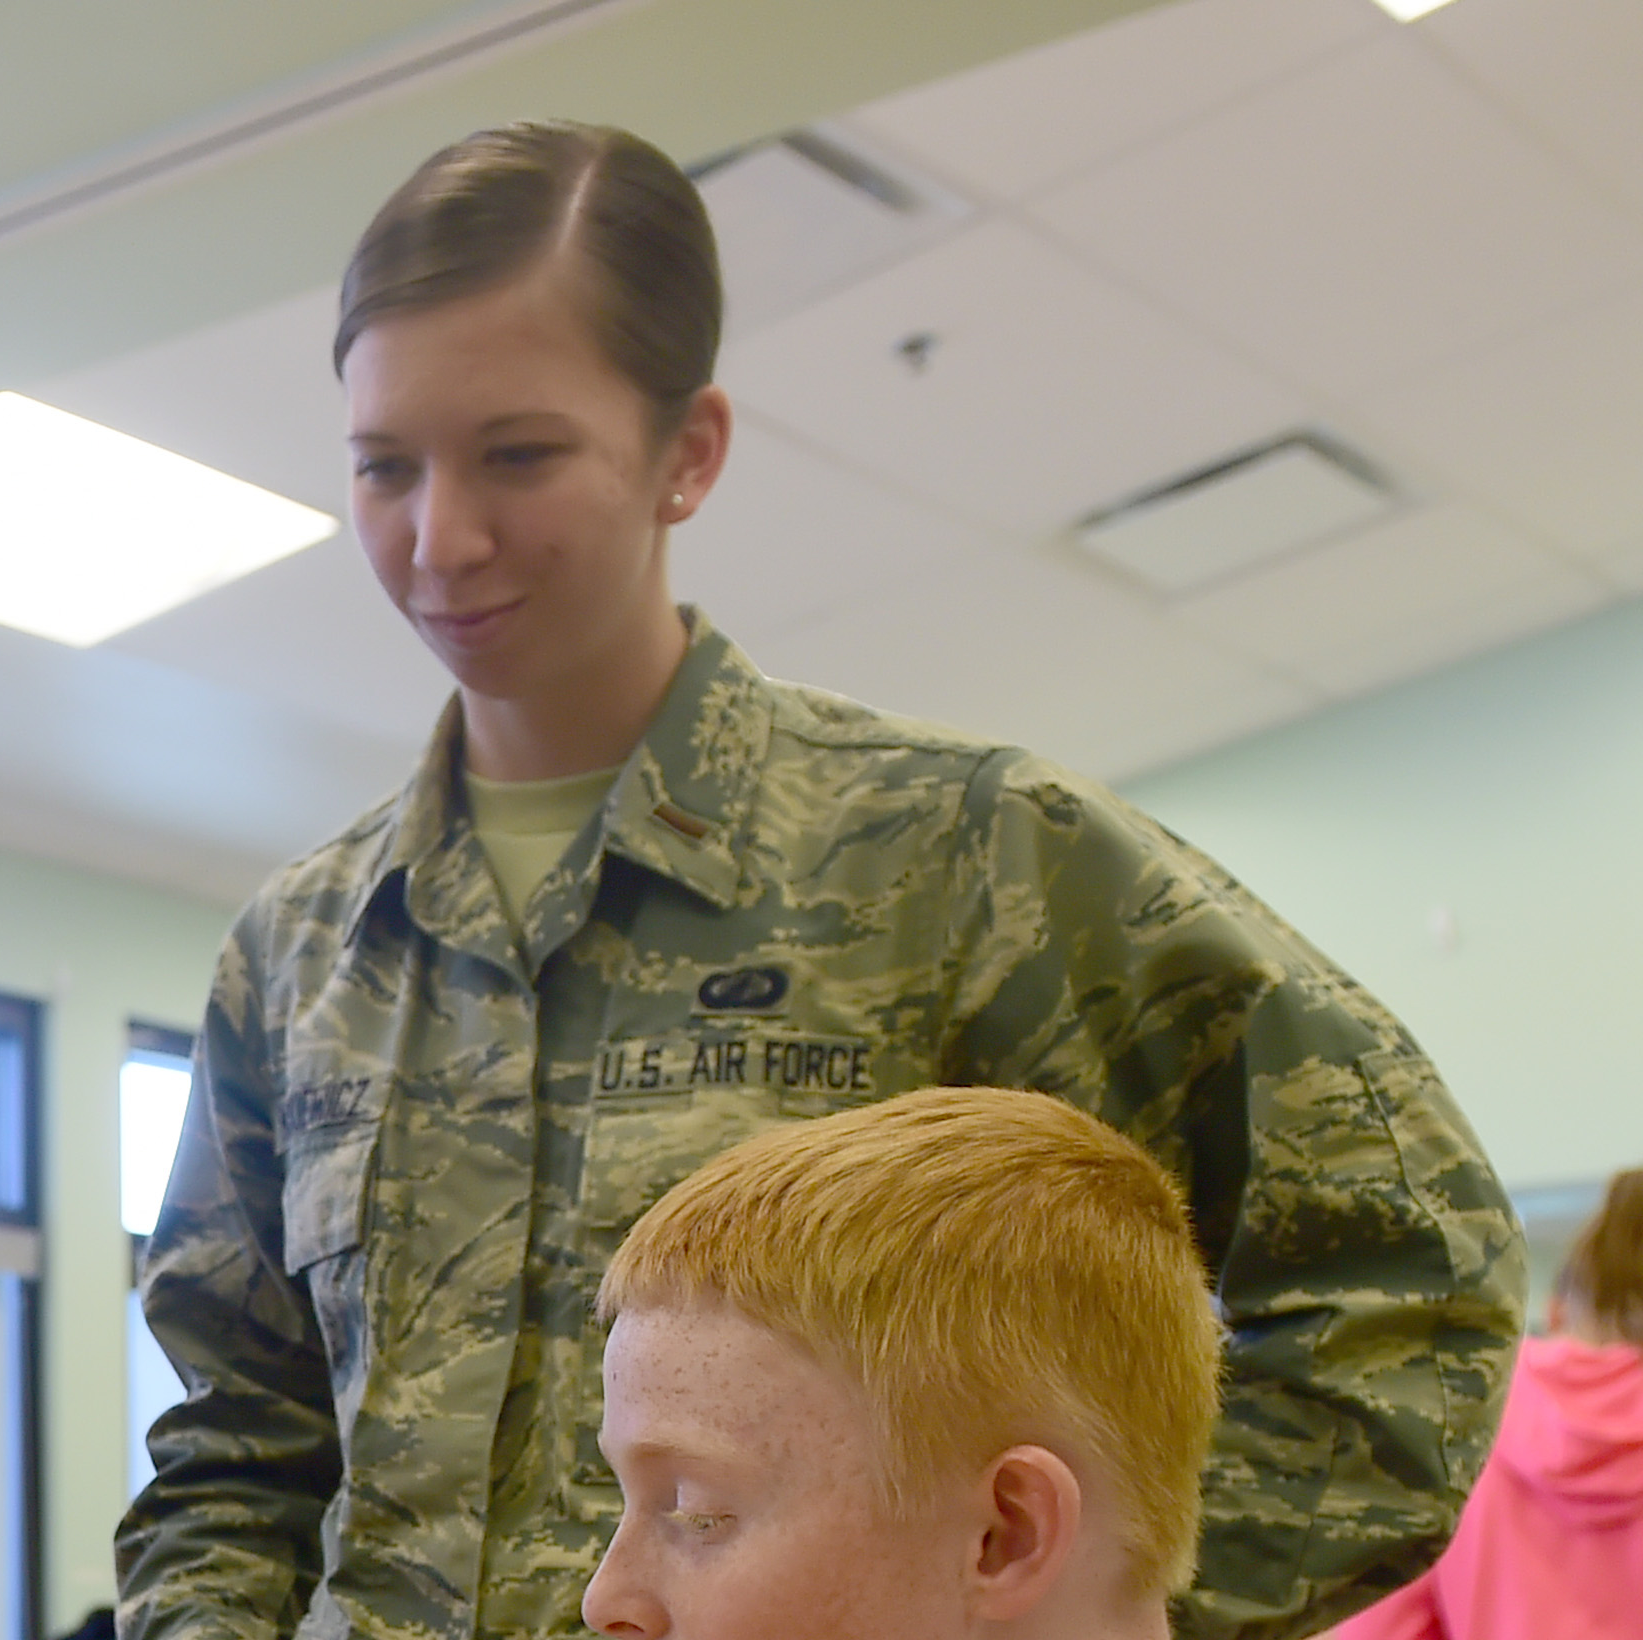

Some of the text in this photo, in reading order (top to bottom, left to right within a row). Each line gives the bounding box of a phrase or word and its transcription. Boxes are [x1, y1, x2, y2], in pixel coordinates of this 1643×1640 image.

[600, 1041, 869, 1090] U.S. AIR FORCE
